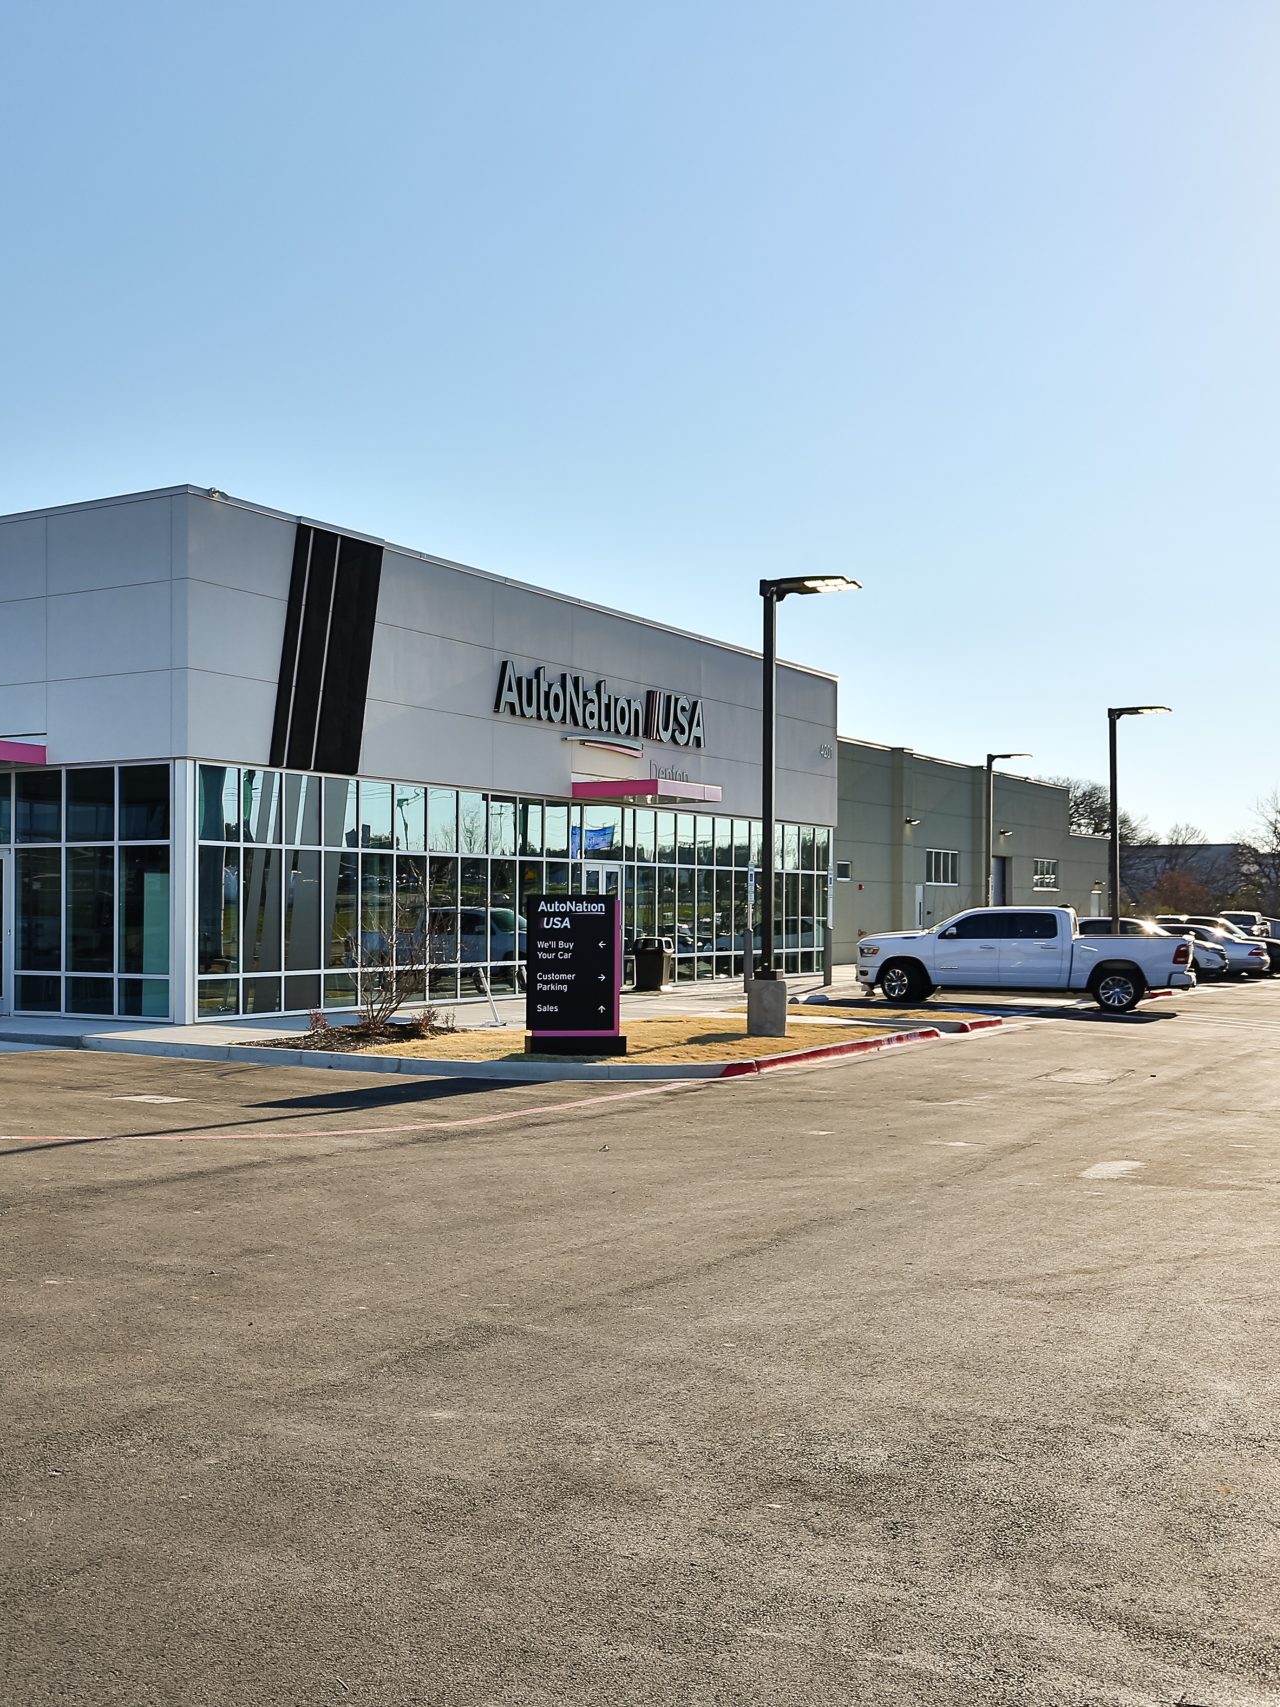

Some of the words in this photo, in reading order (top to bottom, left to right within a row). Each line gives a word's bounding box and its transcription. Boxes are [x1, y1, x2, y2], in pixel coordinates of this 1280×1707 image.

[496, 660, 643, 737] AutoNation
[658, 691, 706, 748] USA
[537, 900, 606, 913] AutoNation
[543, 917, 571, 929] USA
[558, 940, 574, 950] Buy
[536, 951, 556, 959] Your
[557, 951, 572, 959] Car
[536, 972, 576, 981] Customer
[536, 983, 568, 992] Parking
[536, 1004, 559, 1012] Sales
